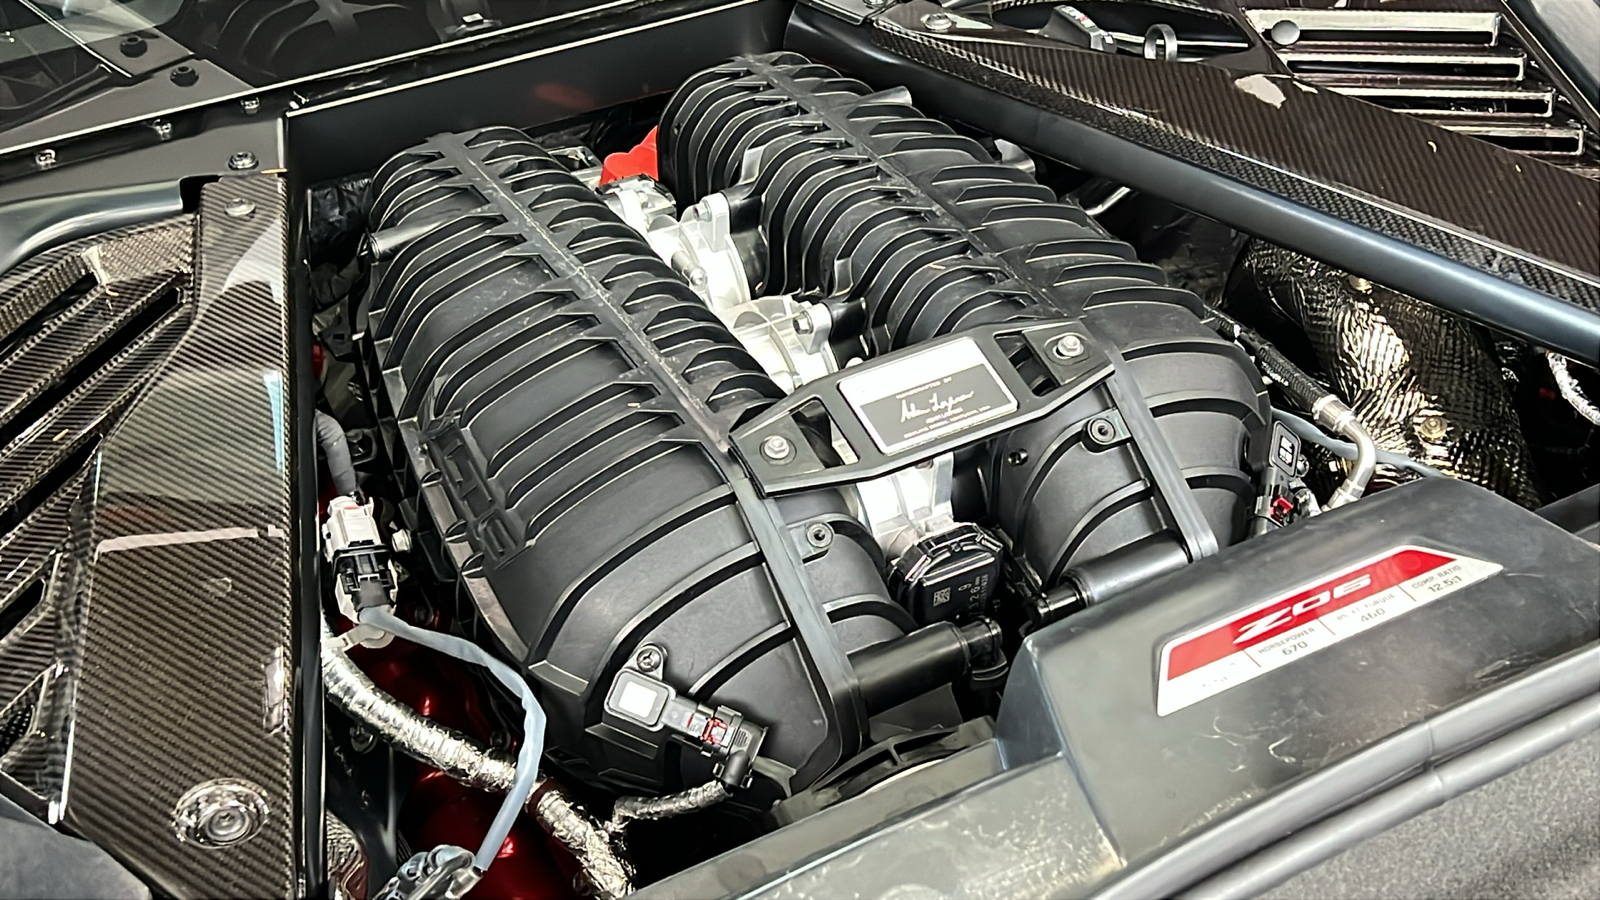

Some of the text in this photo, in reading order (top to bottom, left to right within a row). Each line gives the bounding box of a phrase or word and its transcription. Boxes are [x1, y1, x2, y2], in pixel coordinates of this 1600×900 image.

[1438, 564, 1463, 579] RATIO
[1427, 575, 1463, 593] 12.5:1
[1232, 573, 1372, 645] Z06
[1257, 626, 1316, 654] HORSEPOWER
[1282, 641, 1309, 656] 670
